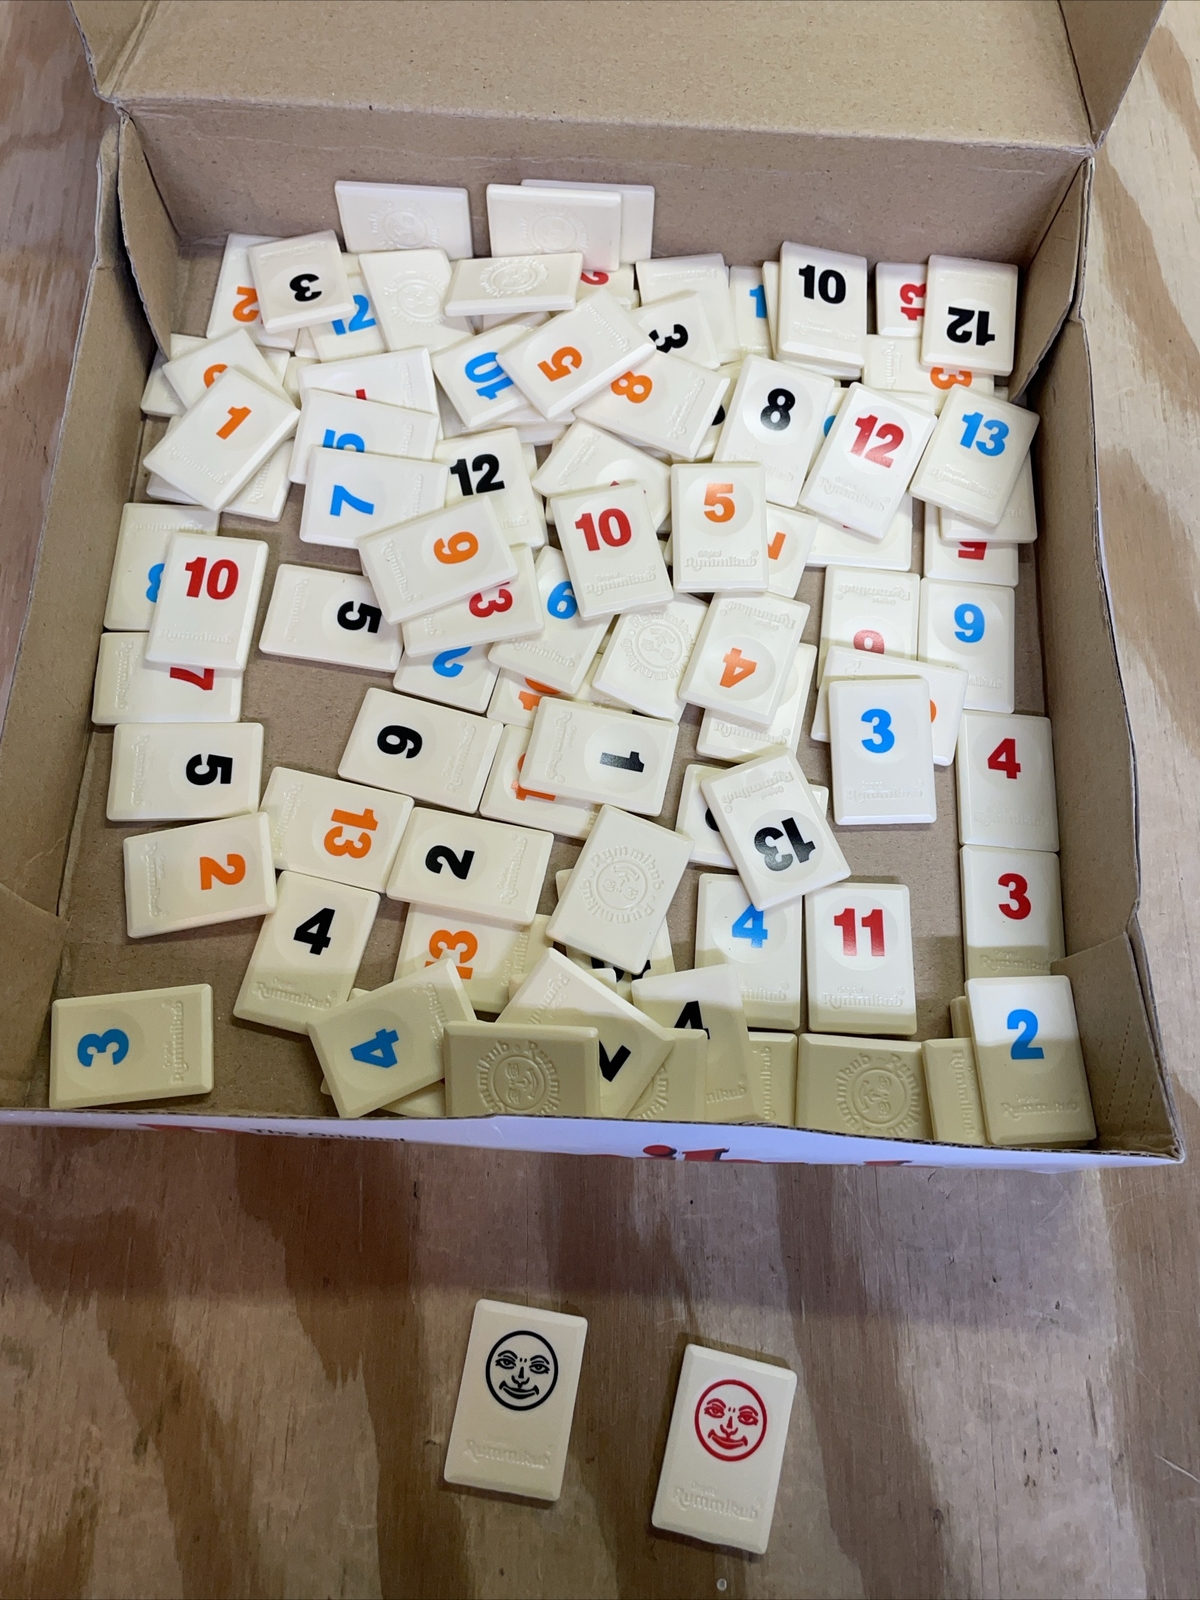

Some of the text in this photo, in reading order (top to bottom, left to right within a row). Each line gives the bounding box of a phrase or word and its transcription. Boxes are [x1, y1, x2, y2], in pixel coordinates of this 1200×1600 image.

[289, 273, 322, 302] 3
[798, 264, 847, 304] 10
[232, 286, 263, 324] 2
[648, 323, 689, 354] 3
[946, 306, 996, 346] 12
[537, 346, 582, 382] 5
[611, 370, 653, 404] 8
[216, 406, 252, 440] 1
[760, 387, 796, 432] 8
[850, 414, 905, 469] 12
[960, 411, 1010, 457] 13
[450, 453, 505, 497] 12
[329, 484, 375, 517] 7
[703, 483, 736, 523] 5
[574, 508, 632, 552] 10
[185, 556, 239, 601] 10
[336, 600, 382, 634] 5
[468, 581, 513, 618] 3
[546, 580, 578, 620] 6
[954, 603, 986, 644] 9
[719, 647, 757, 688] 4
[860, 708, 896, 754] 3
[186, 753, 234, 786] 5
[599, 750, 646, 773] 1
[987, 737, 1022, 780] 4
[323, 808, 379, 860] 13
[754, 816, 817, 872] 13
[199, 853, 247, 891] 2
[424, 844, 476, 881] 2
[997, 873, 1032, 920] 3
[293, 907, 336, 956] 4
[731, 903, 769, 949] 4
[833, 907, 886, 957] 11
[77, 1028, 130, 1068] 3
[350, 1028, 400, 1069] 4
[1007, 1008, 1046, 1060] 2
